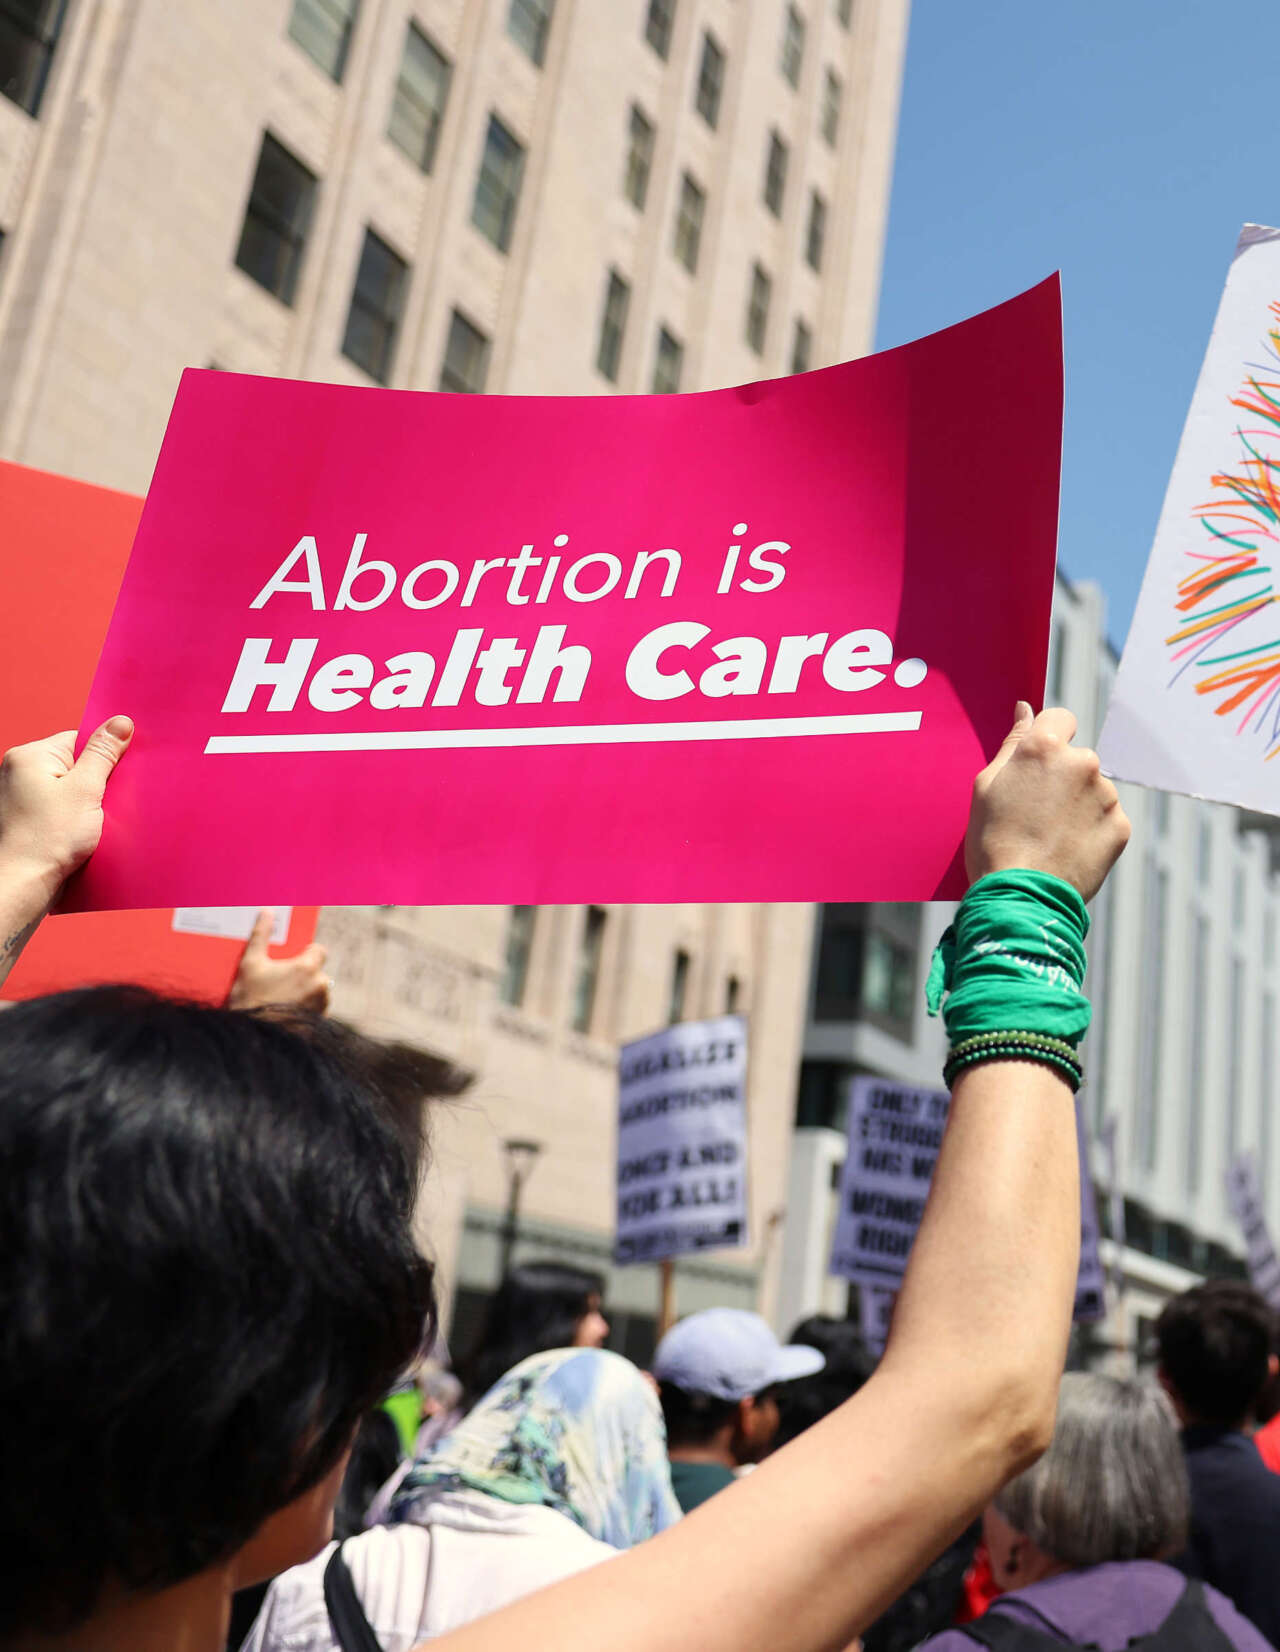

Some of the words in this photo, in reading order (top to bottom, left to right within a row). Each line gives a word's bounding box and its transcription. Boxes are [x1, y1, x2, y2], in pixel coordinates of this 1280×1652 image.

[249, 533, 681, 611] Abortion
[716, 523, 792, 594] is
[220, 624, 592, 713] Health
[624, 620, 928, 701] Care.
